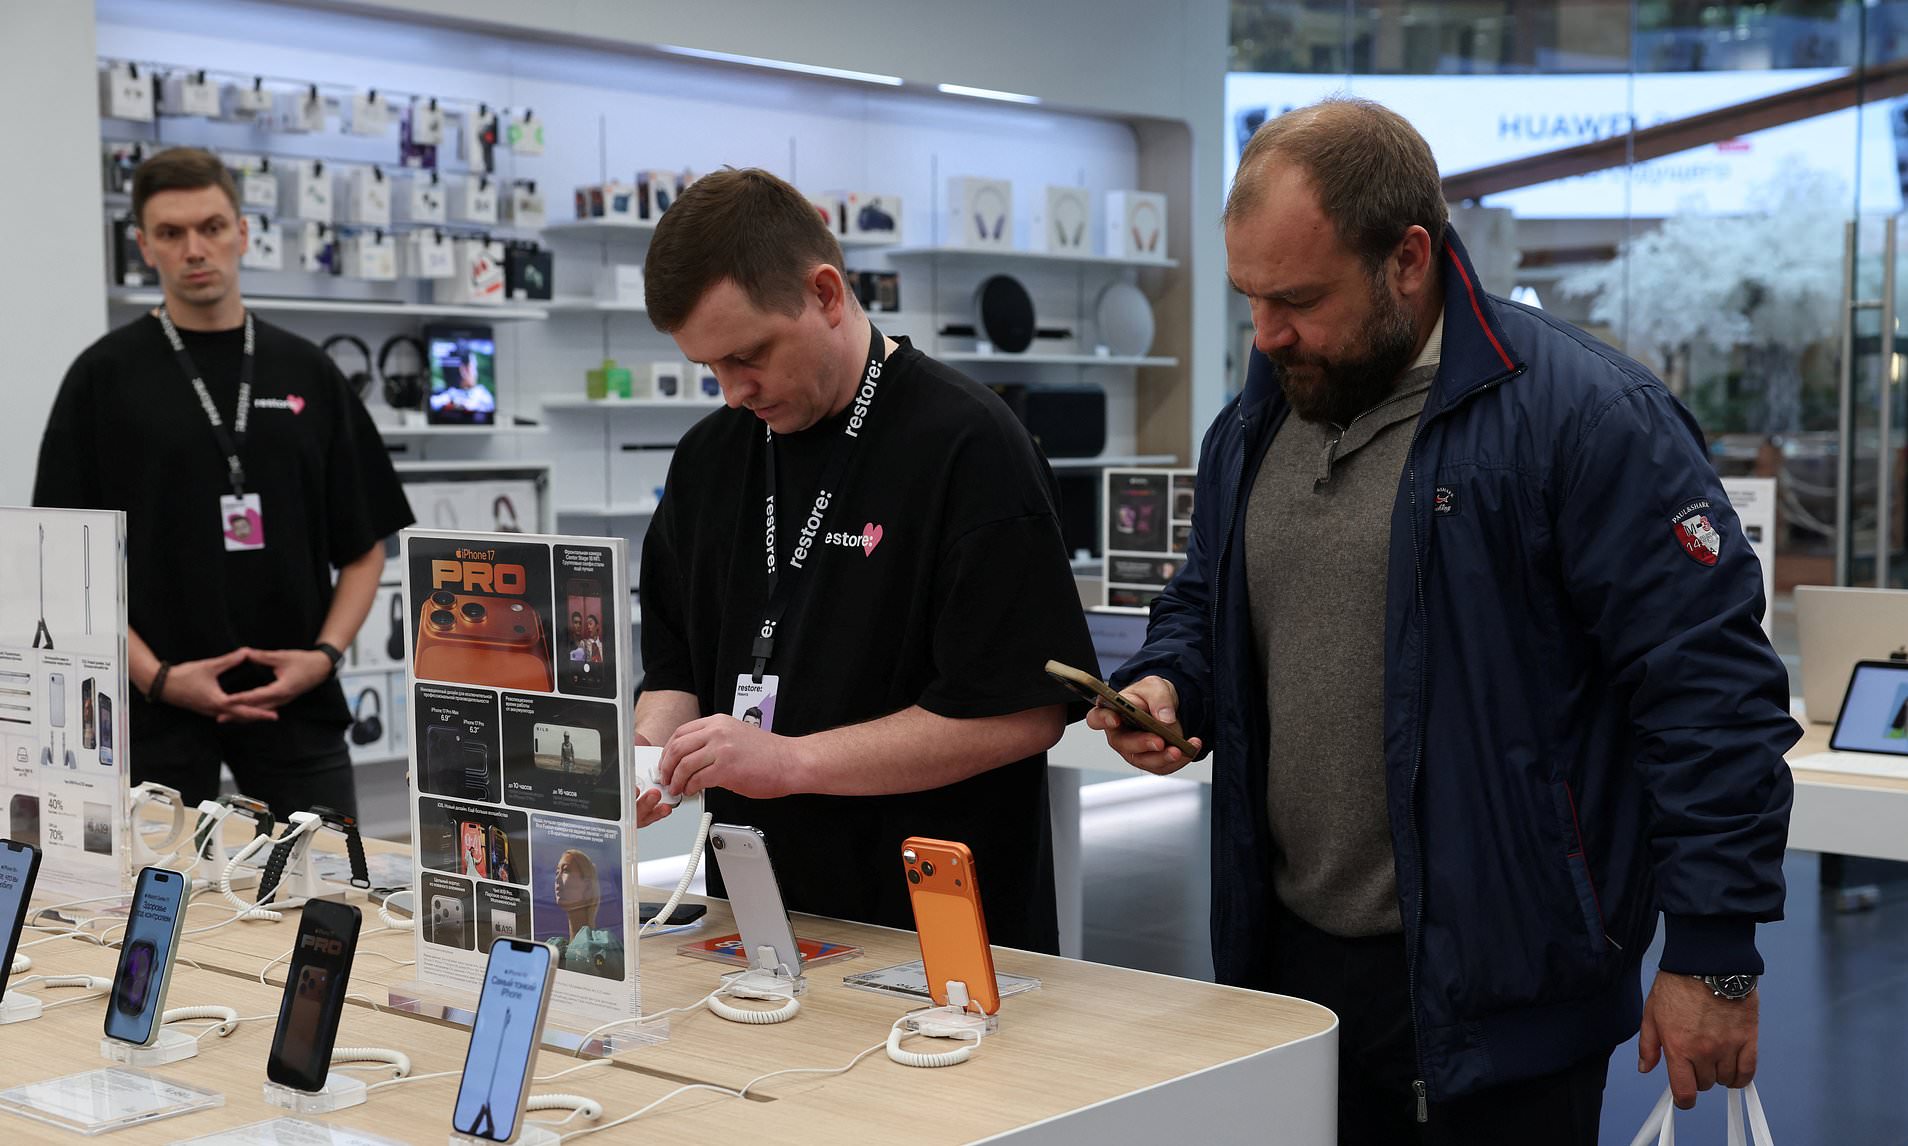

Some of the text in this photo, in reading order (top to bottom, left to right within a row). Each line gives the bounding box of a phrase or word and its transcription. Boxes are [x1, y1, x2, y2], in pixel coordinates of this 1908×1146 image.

[844, 360, 884, 438] restore:
[1672, 501, 1710, 524] PAUL&SHARK
[766, 496, 776, 574] restore:
[790, 490, 833, 569] restore:
[825, 532, 874, 548] estore:
[461, 548, 495, 561] iPhone 17
[431, 560, 526, 595] PRO
[48, 799, 63, 811] 40%
[49, 828, 64, 841] 70%
[301, 934, 341, 954] PRO
[501, 988, 522, 999] iPhone
